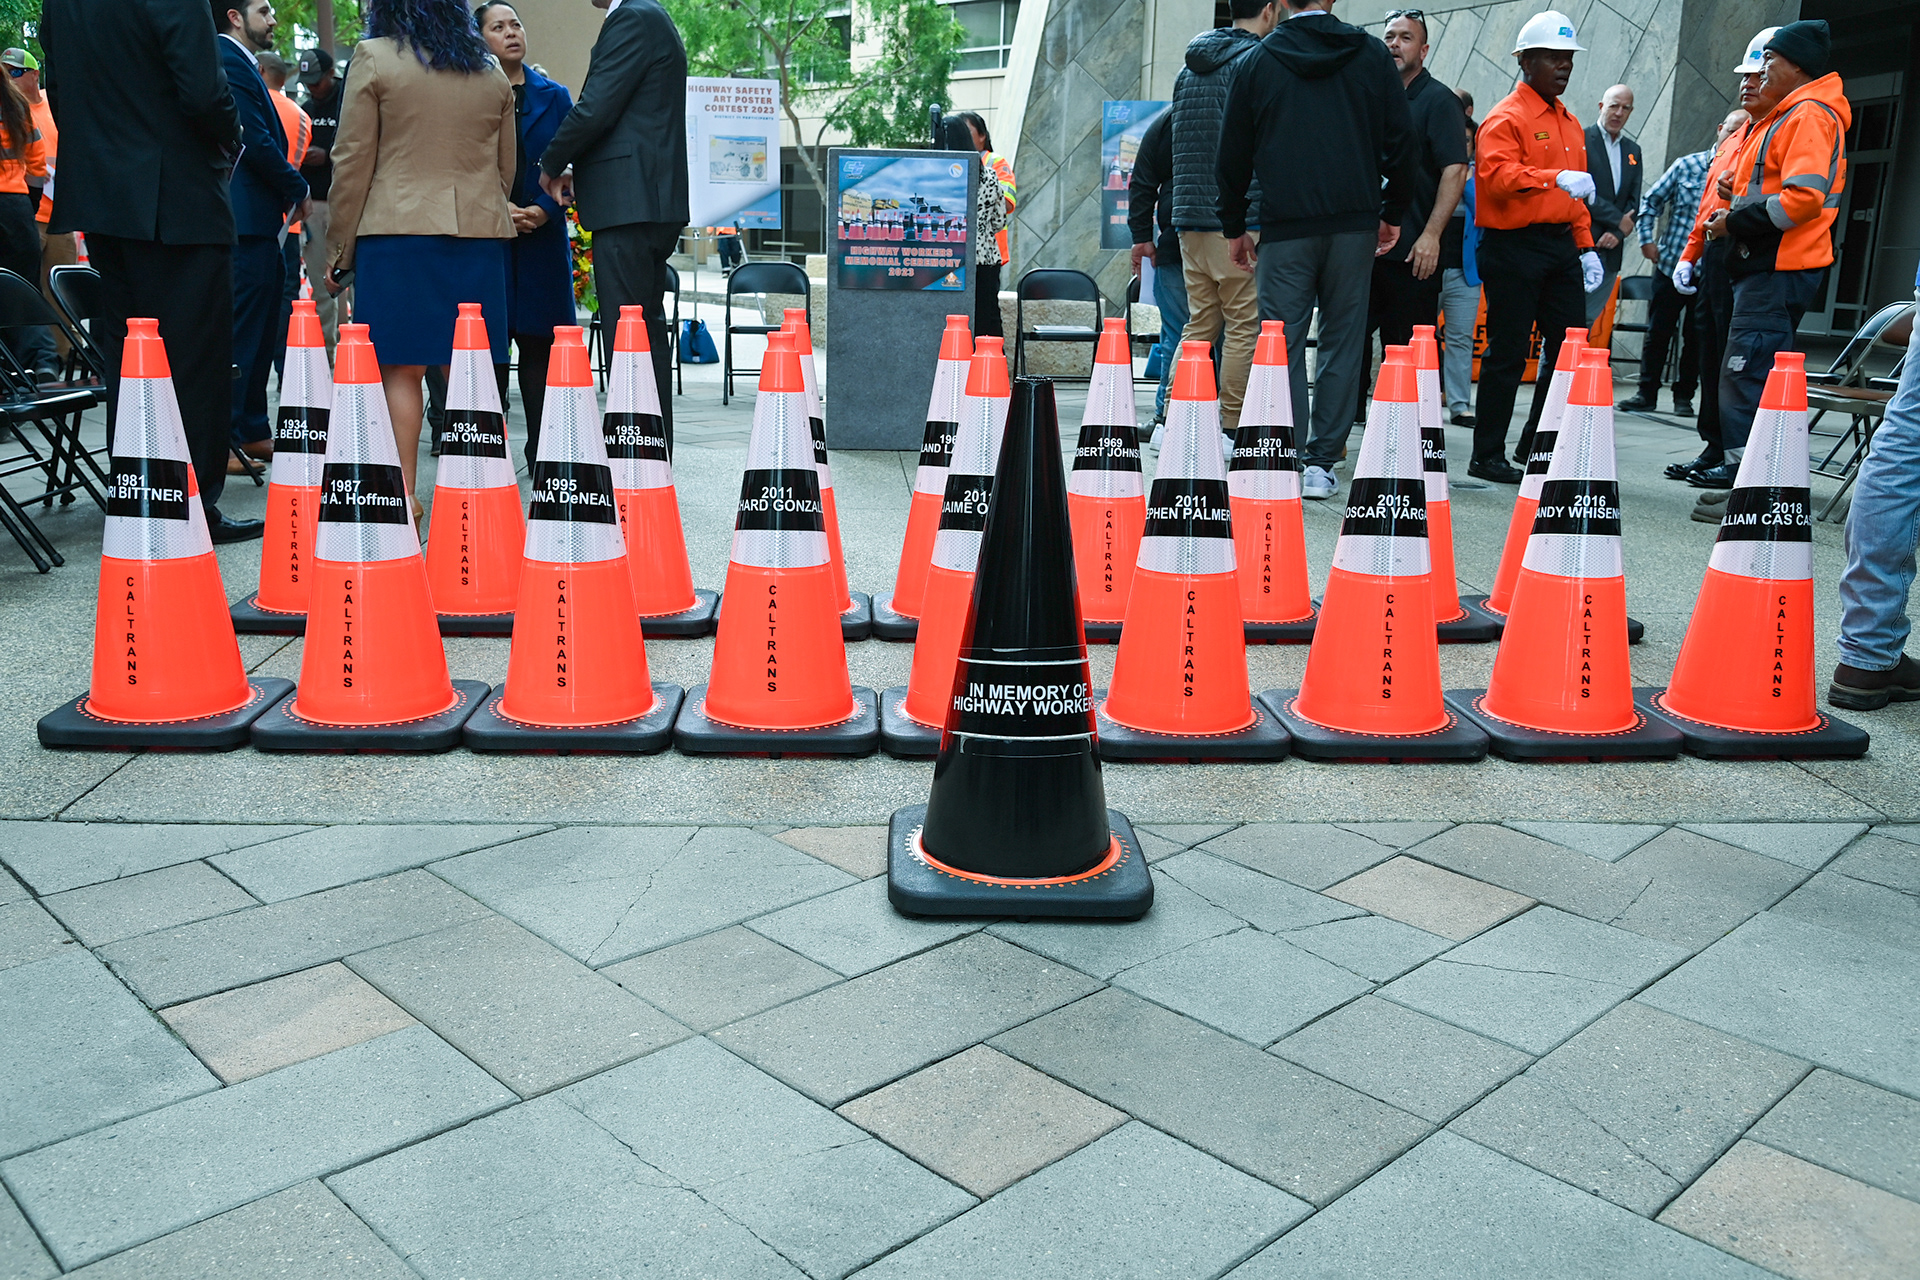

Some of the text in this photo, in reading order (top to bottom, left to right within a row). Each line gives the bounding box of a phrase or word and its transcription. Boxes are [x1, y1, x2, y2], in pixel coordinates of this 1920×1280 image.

[688, 85, 772, 95] HIGHWAY SAFETY
[713, 95, 772, 105] ART POSTER
[704, 104, 774, 114] CONTEST 2023
[850, 246, 953, 257] HIGHWAY WORKERS
[844, 256, 961, 268] MEMORIAL CEREMONY
[888, 267, 915, 277] 2023
[283, 419, 307, 430] 1934
[452, 422, 478, 433] 1934
[615, 425, 641, 436] 1953
[461, 432, 503, 445] OWENS
[618, 435, 665, 448] ROBBINS
[1098, 437, 1123, 448] 1969
[1257, 438, 1282, 448] 1970
[116, 473, 145, 487] 1981
[330, 479, 361, 492] 1987
[545, 478, 577, 491] 1995
[118, 486, 184, 503] BITTNER
[559, 491, 612, 507] DeNEAL
[761, 486, 792, 499] 2011
[346, 492, 403, 507] Hoffman
[1175, 495, 1206, 507] 2011
[1377, 494, 1410, 507] 2015
[1574, 495, 1606, 507] 2016
[1345, 506, 1386, 519] OSCAR
[1772, 502, 1802, 514] 2018
[1761, 513, 1793, 526] CAS
[290, 498, 299, 583] CALTRANS
[461, 501, 469, 586] CALTRANS
[1104, 510, 1113, 593] CALTRANS
[1263, 512, 1272, 594] CALTRANS
[126, 576, 137, 685] CALTRANS
[343, 579, 354, 688] CALTRANS
[557, 580, 567, 687] CALTRANS
[767, 585, 778, 692] CALTRANS
[1183, 590, 1196, 697] CALTRANS
[1381, 594, 1396, 699] CALTRANS
[1580, 594, 1593, 698] CALTRANS
[1772, 595, 1787, 698] CALTRANS
[969, 683, 1087, 700] IN MEMORY OF
[953, 696, 1027, 716] HIGHWAY
